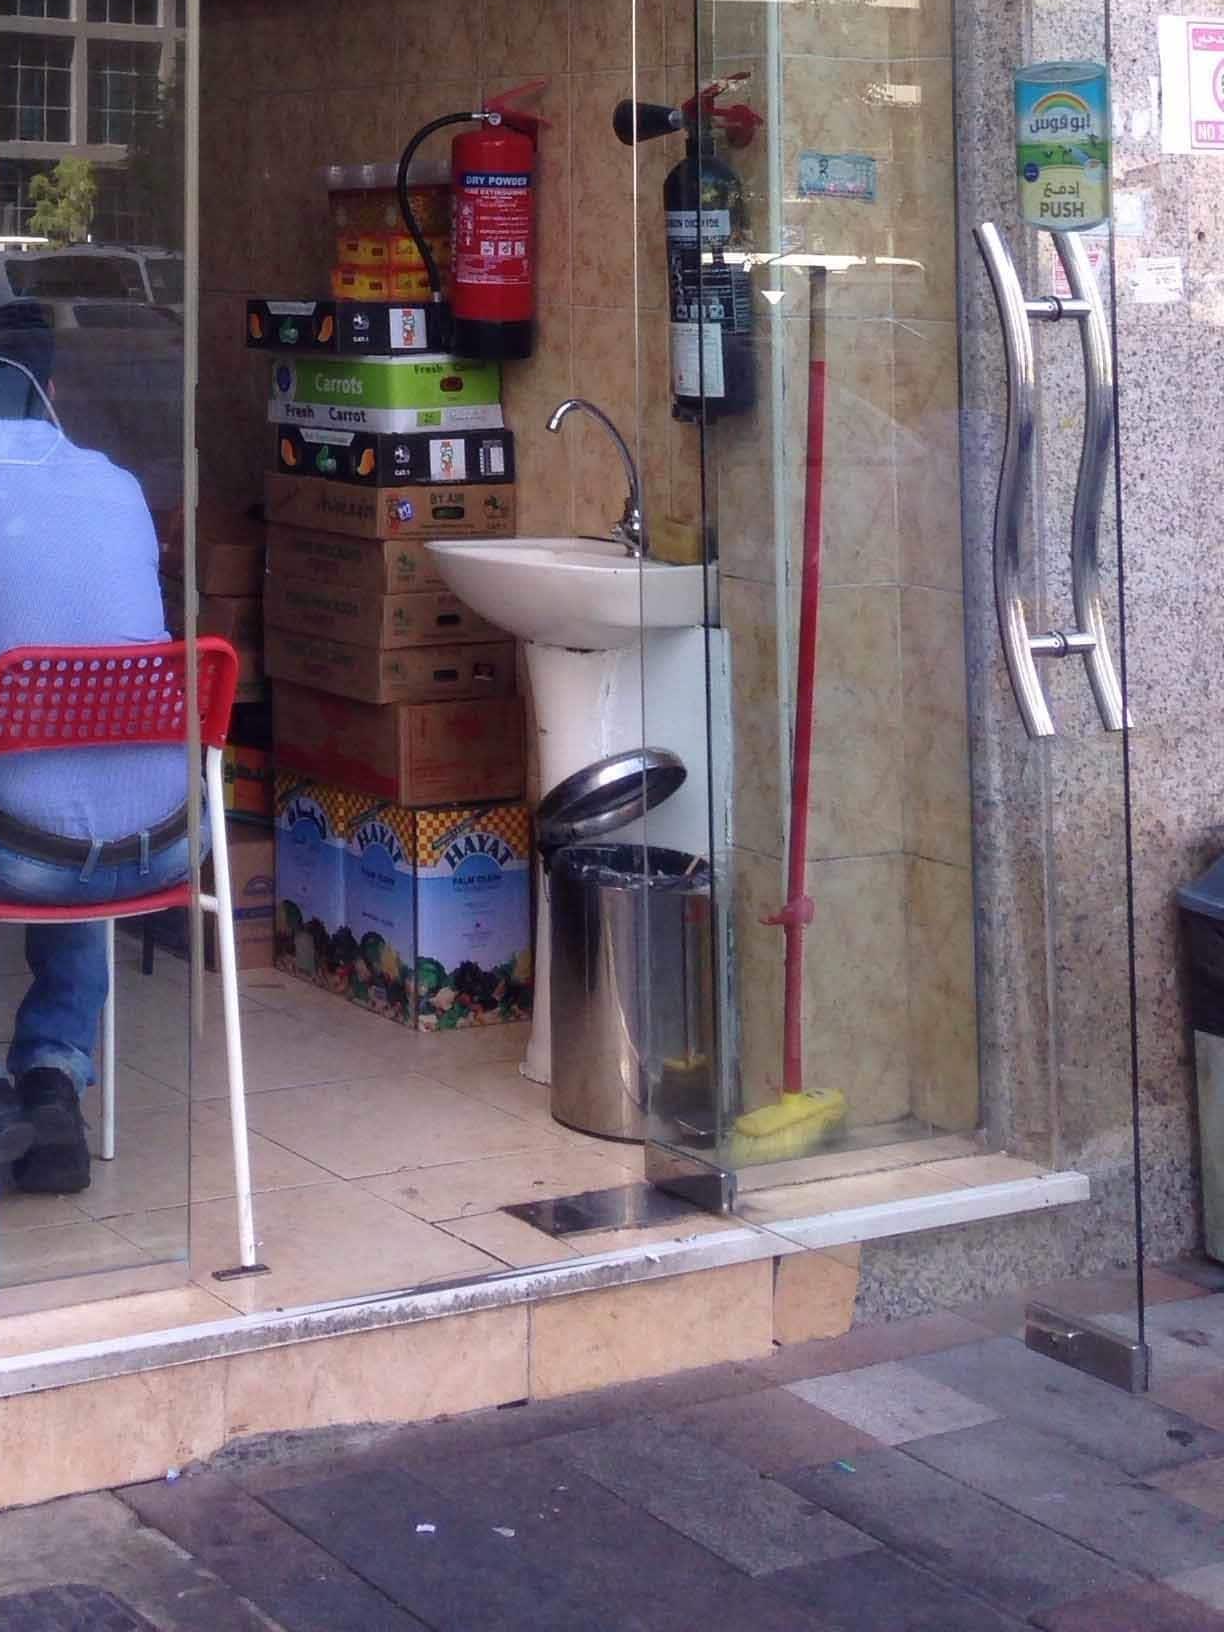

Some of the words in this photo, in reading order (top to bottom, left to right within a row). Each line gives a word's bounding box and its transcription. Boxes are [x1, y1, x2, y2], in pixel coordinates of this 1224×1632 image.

[466, 175, 485, 185] DRY
[1039, 202, 1084, 218] PUSH
[314, 372, 363, 395] Carrots
[285, 403, 314, 418] Fresh
[329, 407, 366, 423] Carrot
[357, 823, 403, 863] HAYAT
[444, 833, 514, 870] HAYAT
